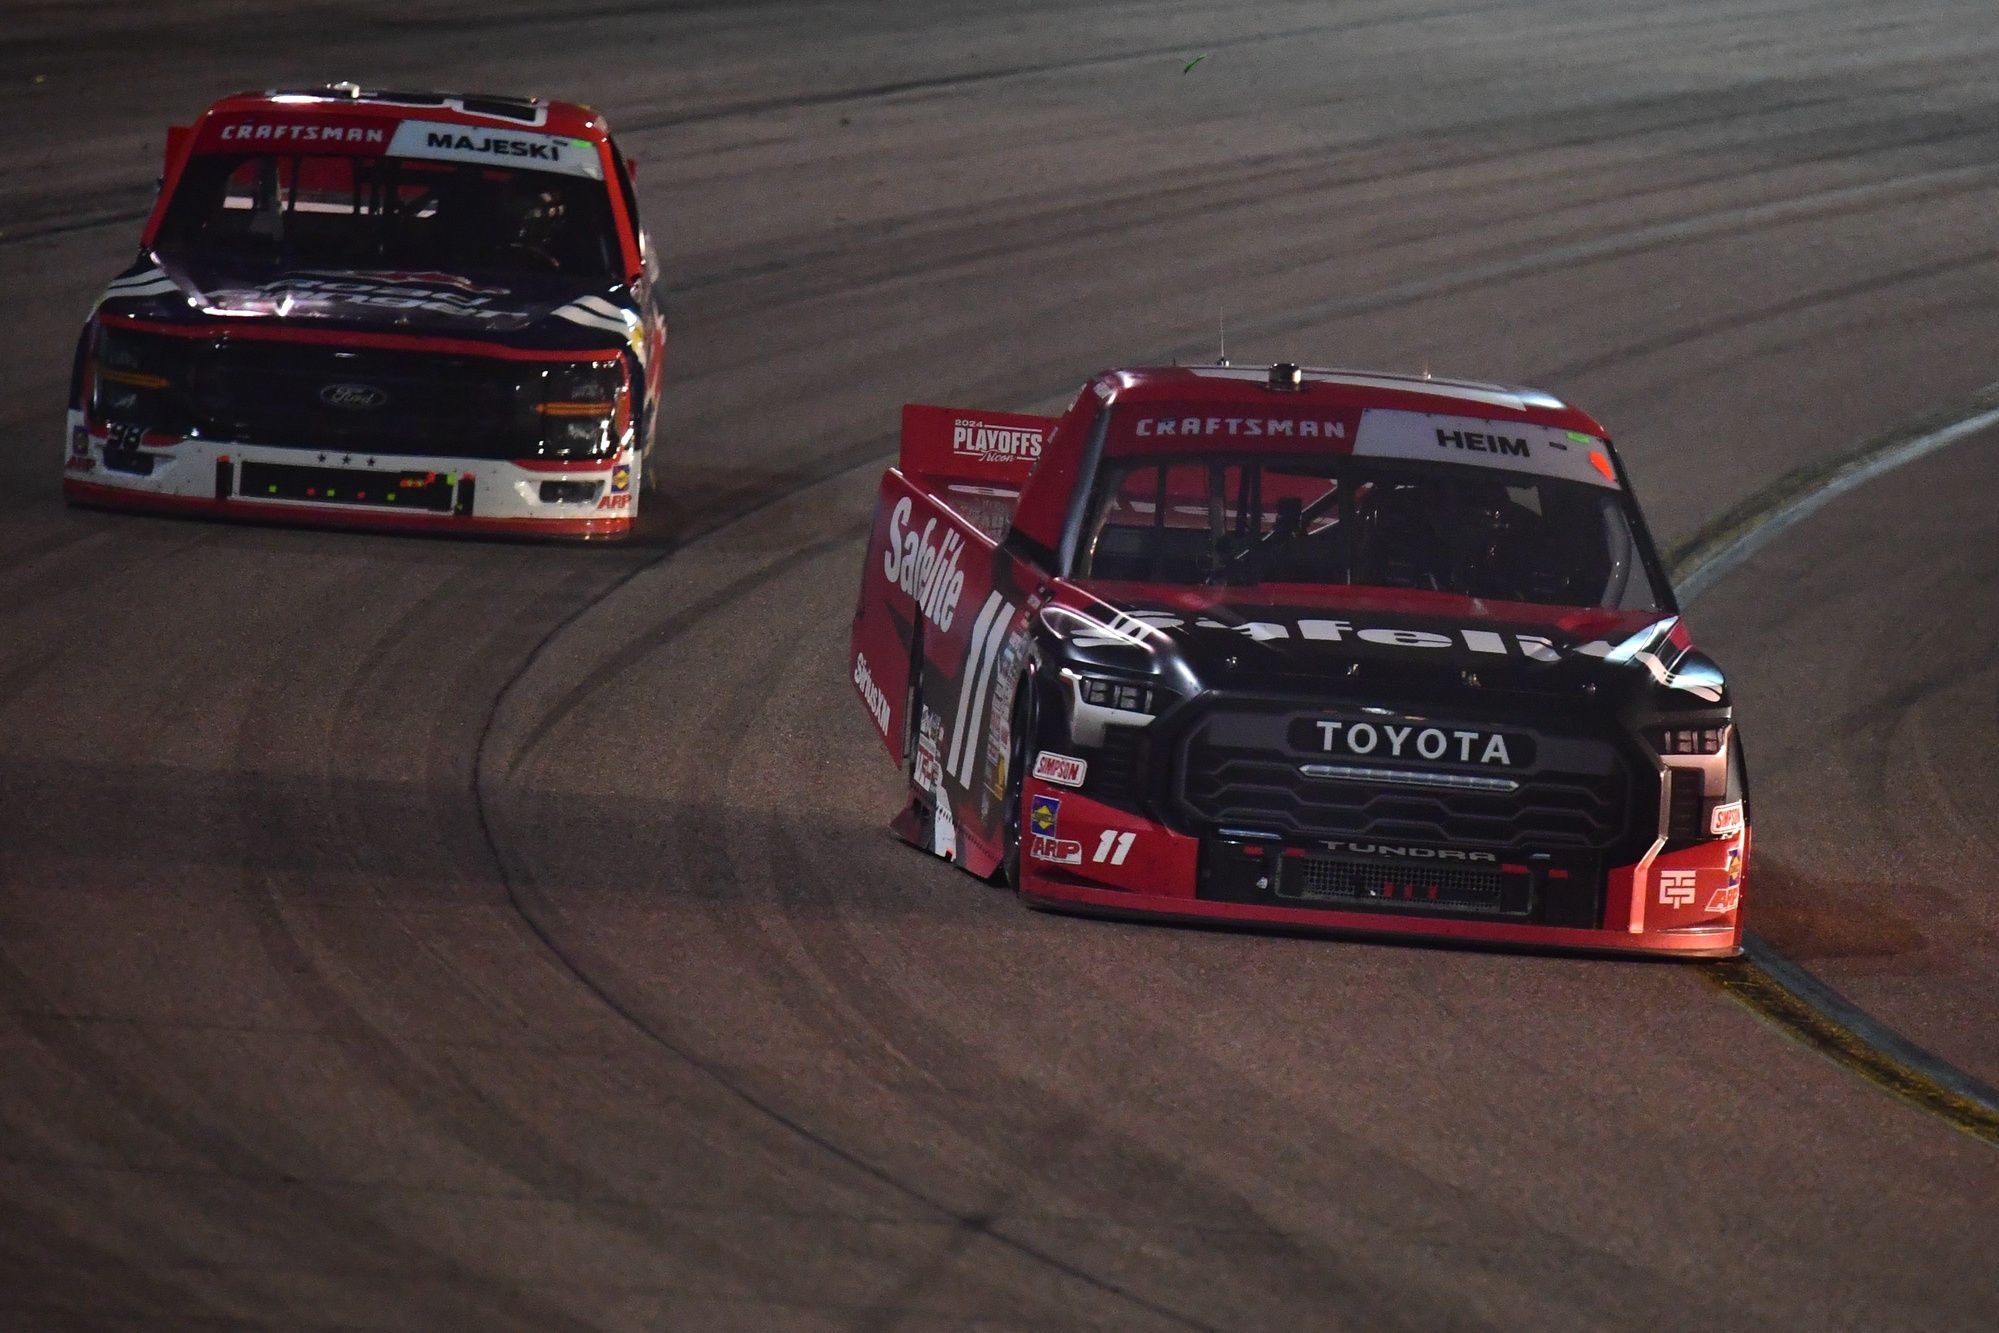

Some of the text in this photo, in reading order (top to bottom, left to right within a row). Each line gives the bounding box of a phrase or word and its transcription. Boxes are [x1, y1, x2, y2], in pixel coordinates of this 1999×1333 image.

[220, 124, 384, 143] CRAFTSMAN
[427, 132, 560, 162] MAJESKI
[954, 418, 984, 428] 2024
[1135, 417, 1346, 439] CRAFTSMAN
[953, 427, 1043, 457] PLAYOFFS
[1436, 427, 1531, 458] HEIM
[597, 494, 632, 510] ARP
[1316, 720, 1511, 765] TOYOTA
[1036, 756, 1080, 781] SIMPSON
[1033, 836, 1081, 861] ARP
[1092, 829, 1137, 866] 11
[1318, 839, 1497, 863] TUNDRA
